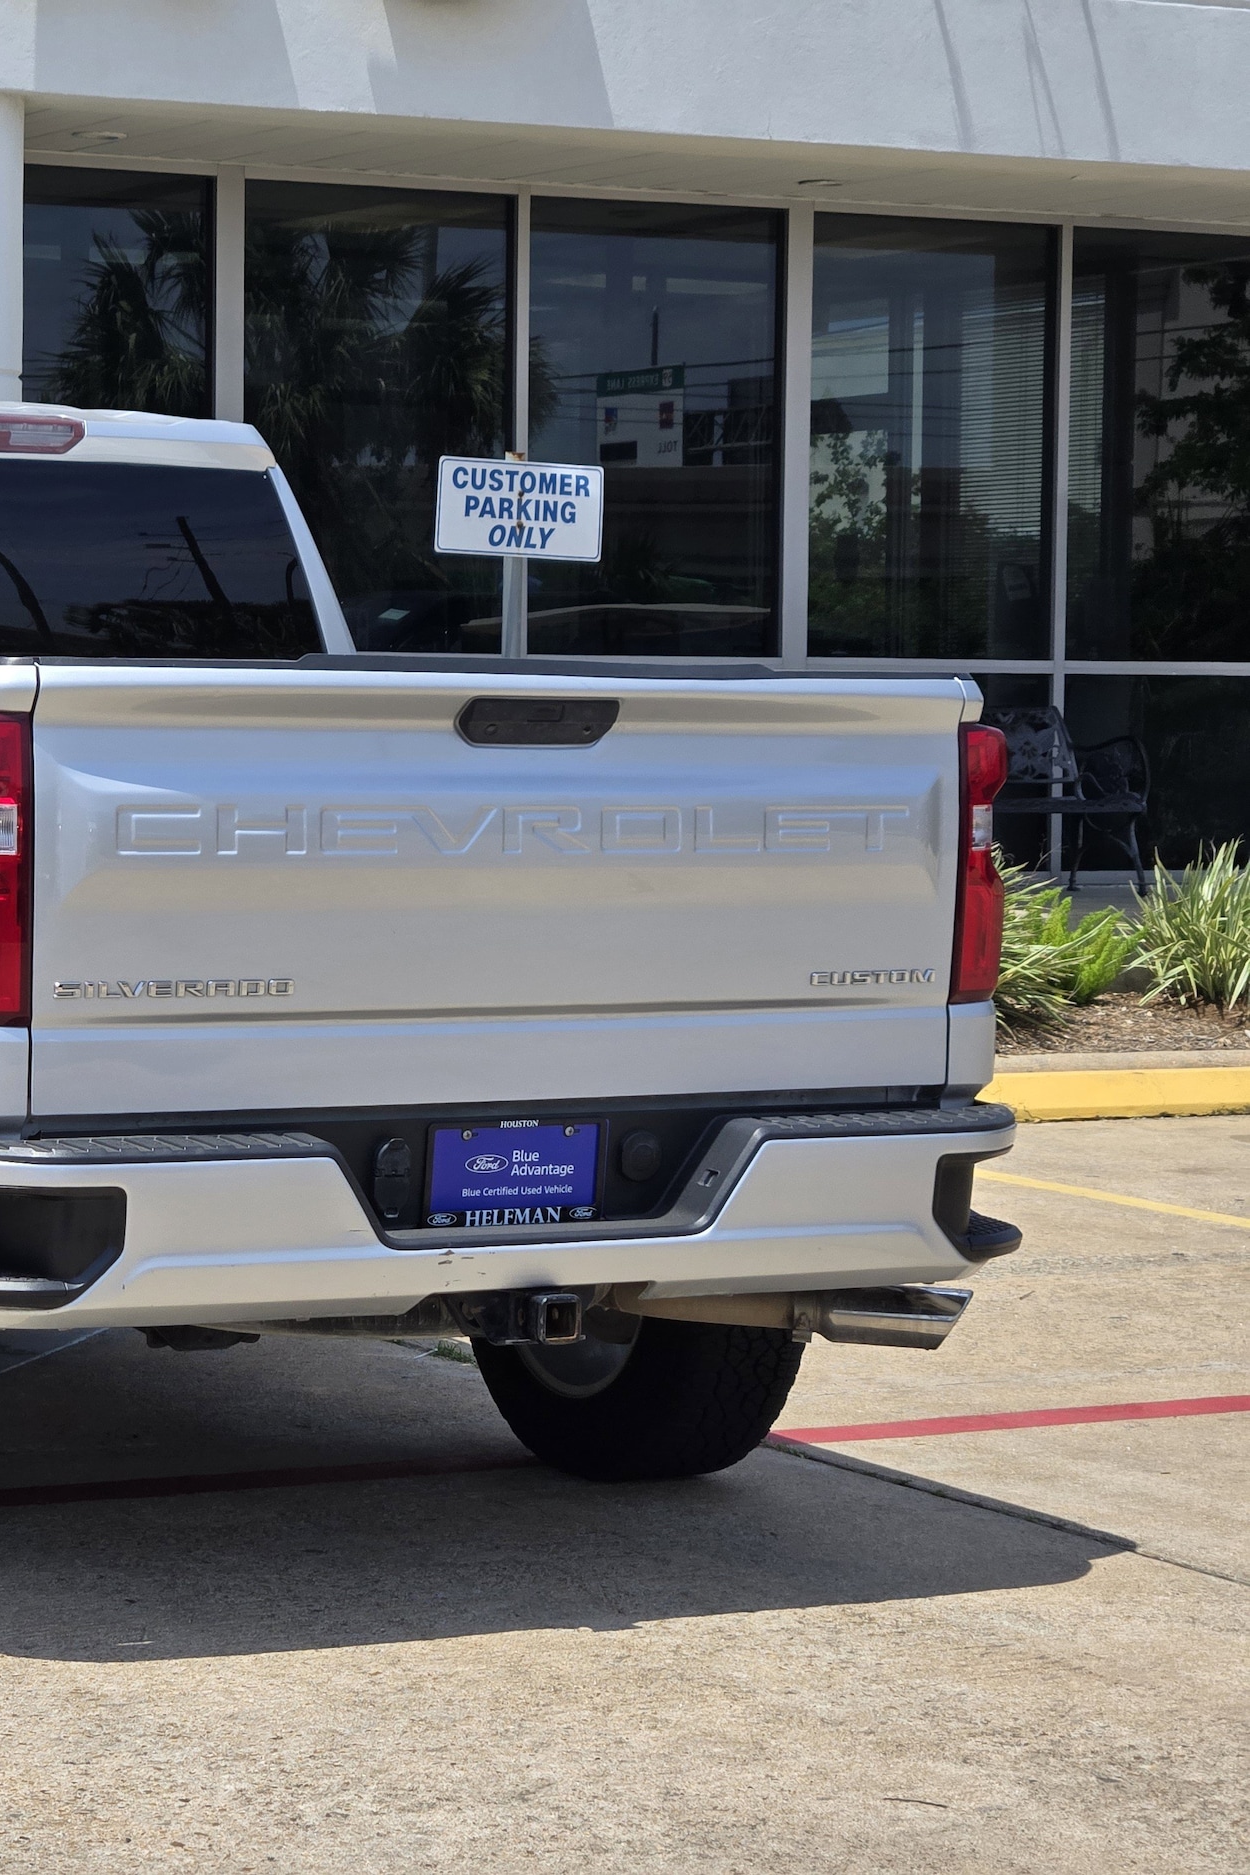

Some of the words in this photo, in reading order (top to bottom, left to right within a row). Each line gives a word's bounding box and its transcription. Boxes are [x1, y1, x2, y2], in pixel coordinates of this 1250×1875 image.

[452, 466, 590, 498] CUSTOMER
[464, 495, 577, 524] PARKING
[488, 524, 556, 550] ONLY
[116, 804, 910, 856] CHEVROLET
[809, 968, 936, 987] CUSTOM
[52, 978, 296, 999] SILVERADO
[500, 1119, 540, 1129] HOUSTON
[472, 1157, 501, 1171] Ford
[512, 1150, 540, 1162] Blue
[510, 1163, 574, 1177] Advantage
[461, 1188, 481, 1197] Blue
[483, 1186, 519, 1196] Certified
[520, 1186, 542, 1195] Used
[544, 1184, 573, 1194] Vehicle
[464, 1206, 562, 1227] HELFMAN
